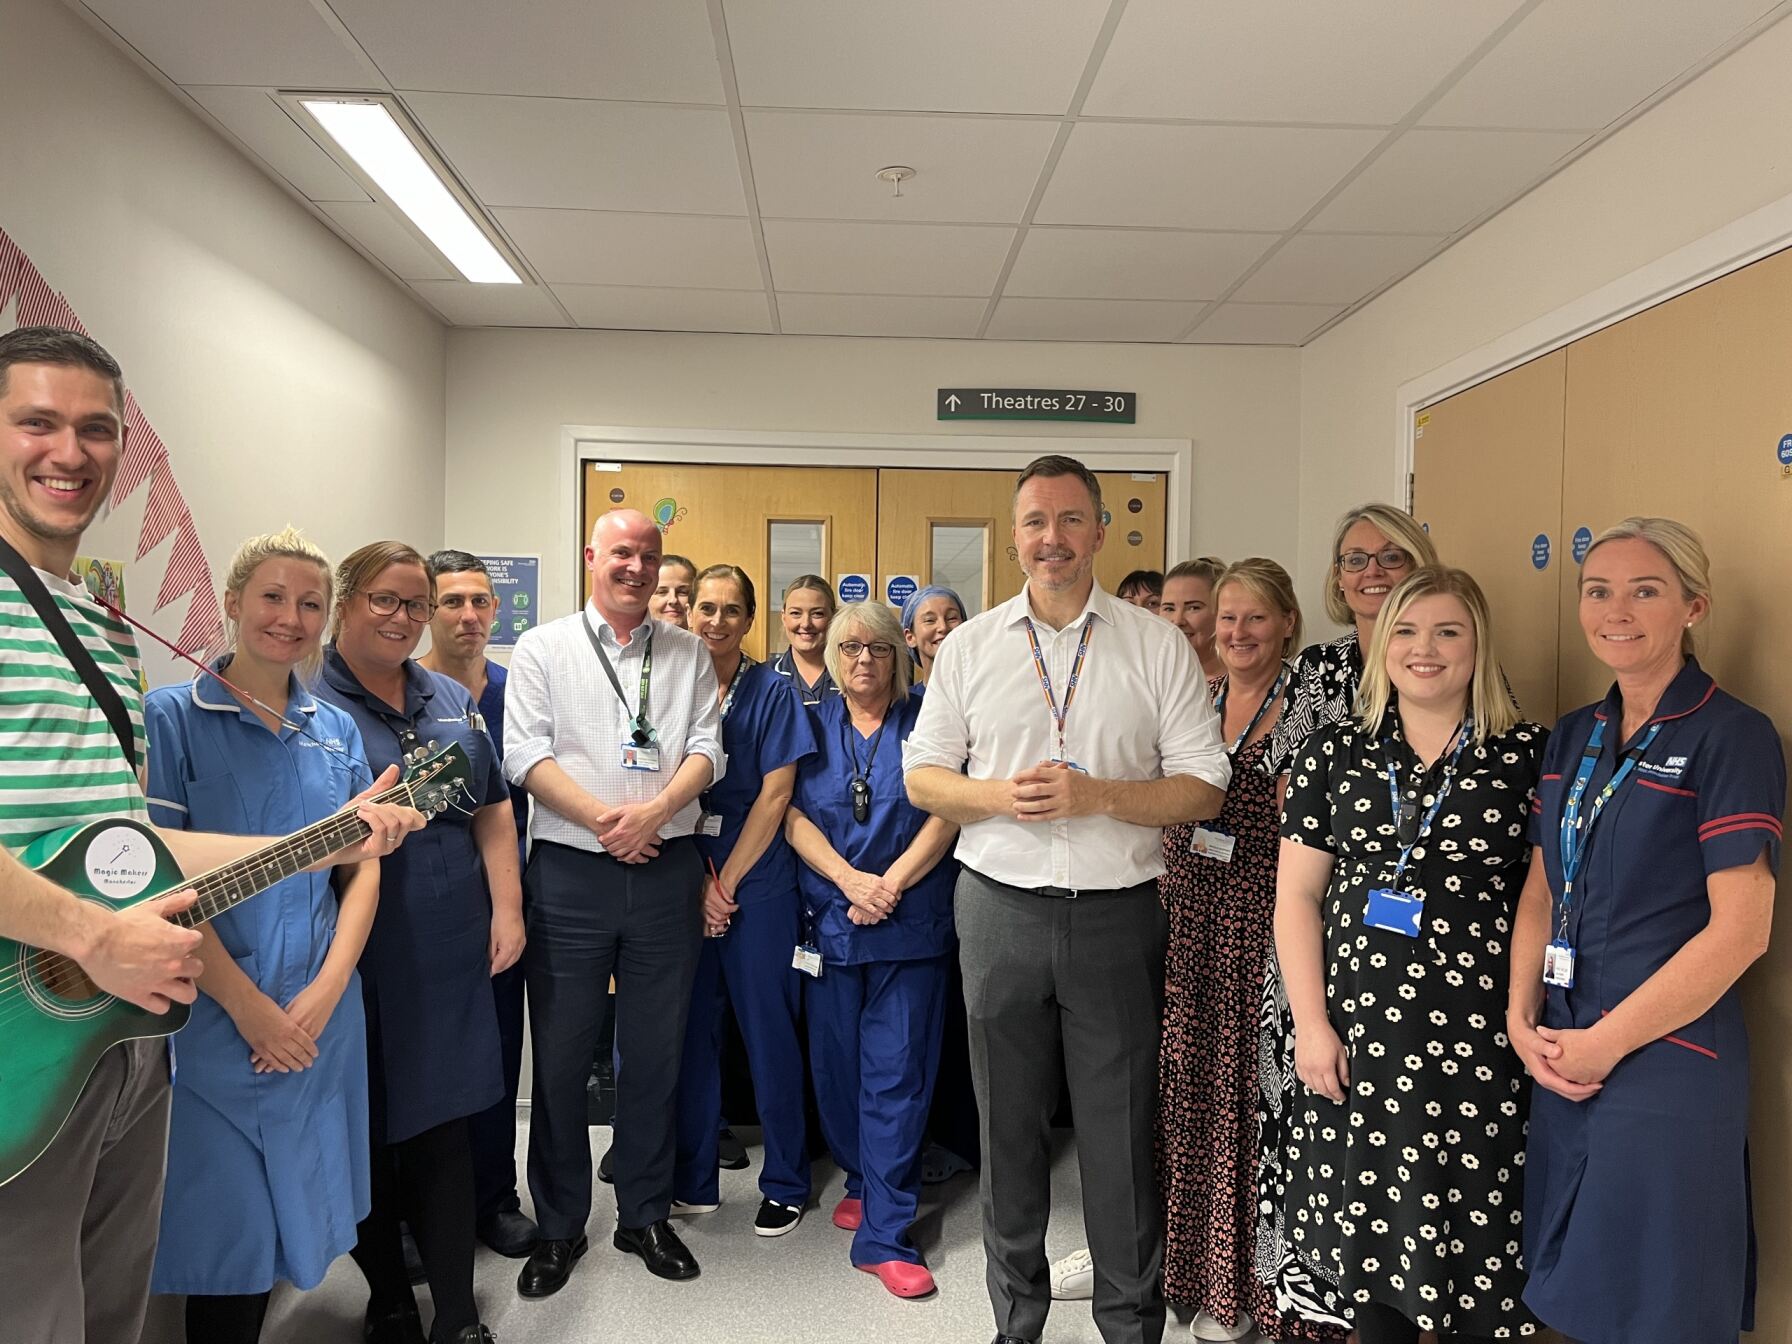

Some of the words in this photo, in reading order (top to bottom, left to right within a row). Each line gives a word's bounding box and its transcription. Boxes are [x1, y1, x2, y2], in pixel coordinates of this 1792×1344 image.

[980, 392, 1060, 410] Theatres
[1064, 394, 1087, 411] 27
[1103, 396, 1125, 412] 30
[1665, 756, 1688, 767] NHS
[1652, 764, 1683, 775] University
[93, 867, 118, 876] Magic
